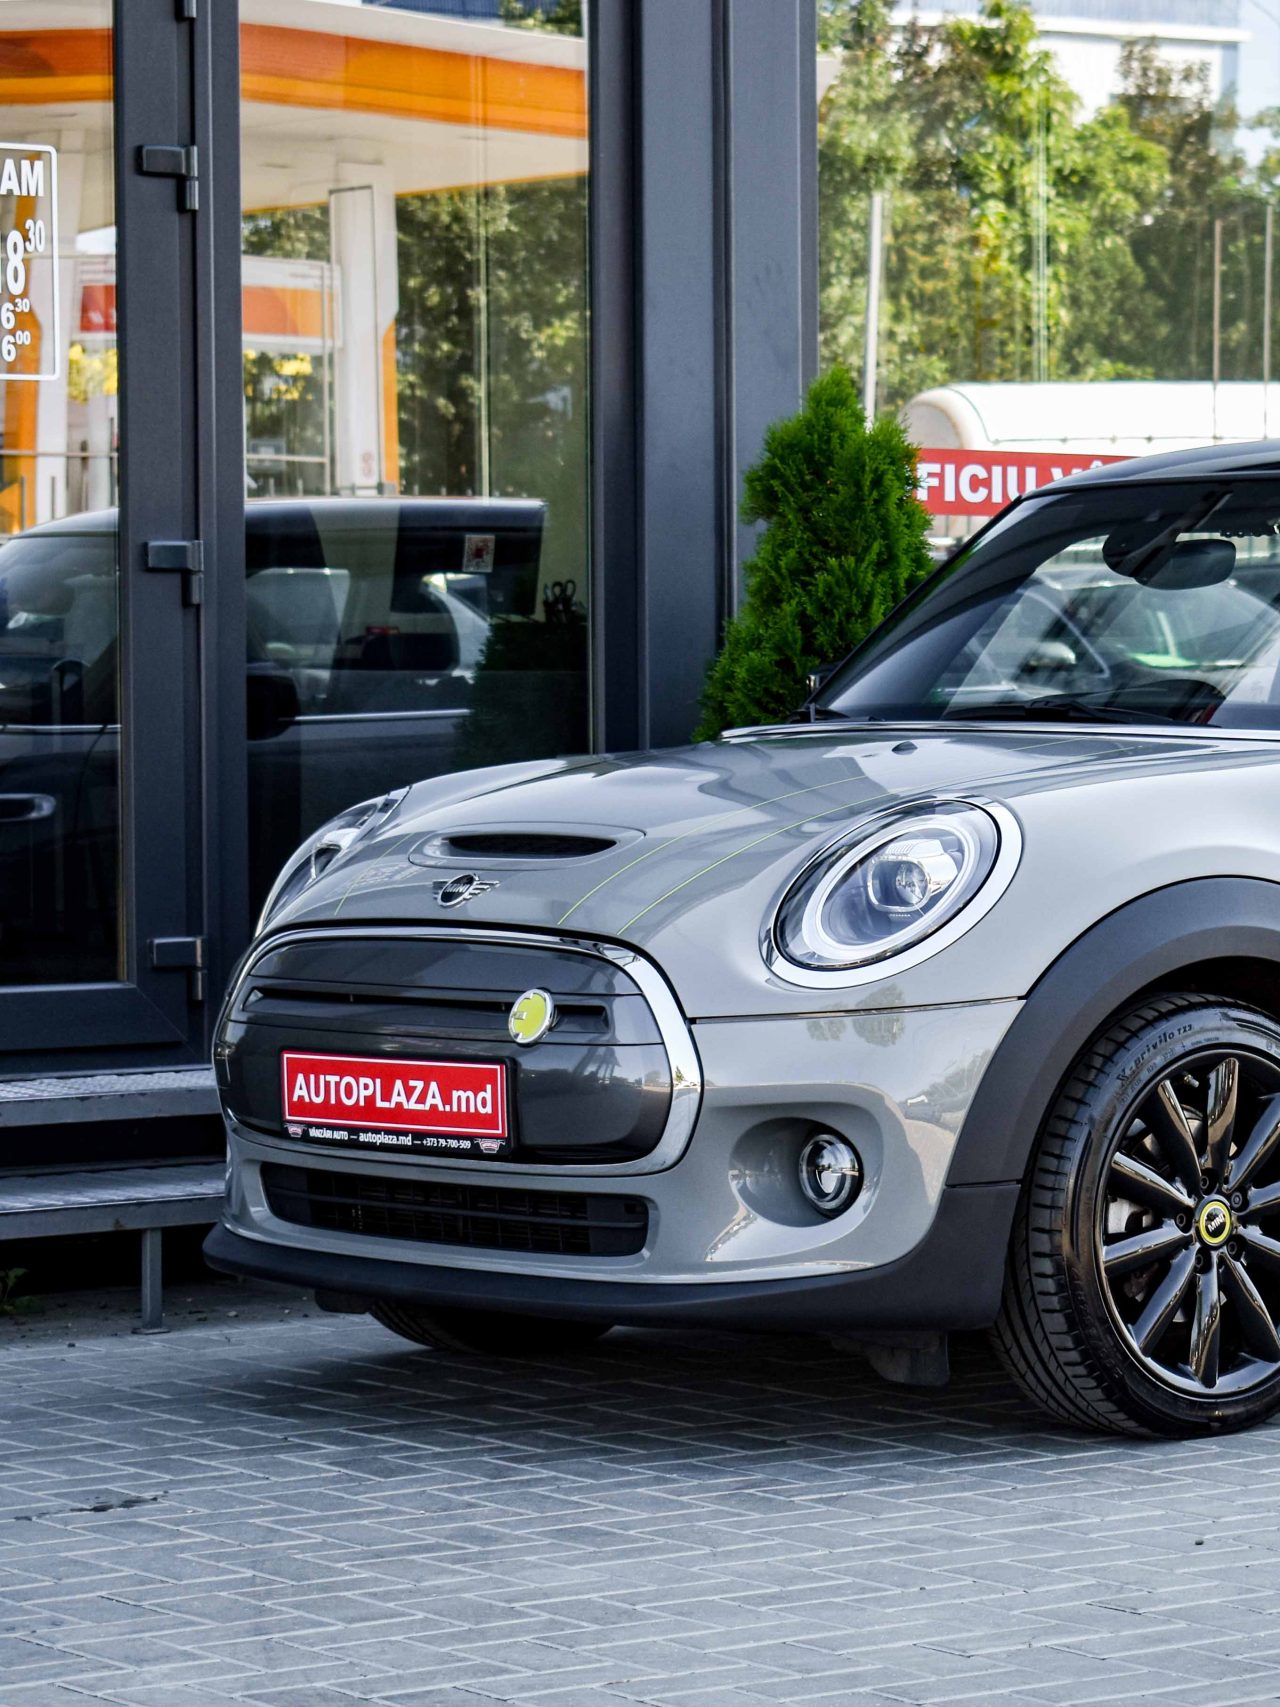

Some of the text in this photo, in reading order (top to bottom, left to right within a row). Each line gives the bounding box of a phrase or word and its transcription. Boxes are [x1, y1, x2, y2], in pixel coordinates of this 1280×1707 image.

[292, 1073, 493, 1115] AUTOPLAZA.md
[332, 1130, 349, 1141] AUTO
[358, 1131, 413, 1147] autoplaza.md
[1207, 1212, 1226, 1233] MINI
